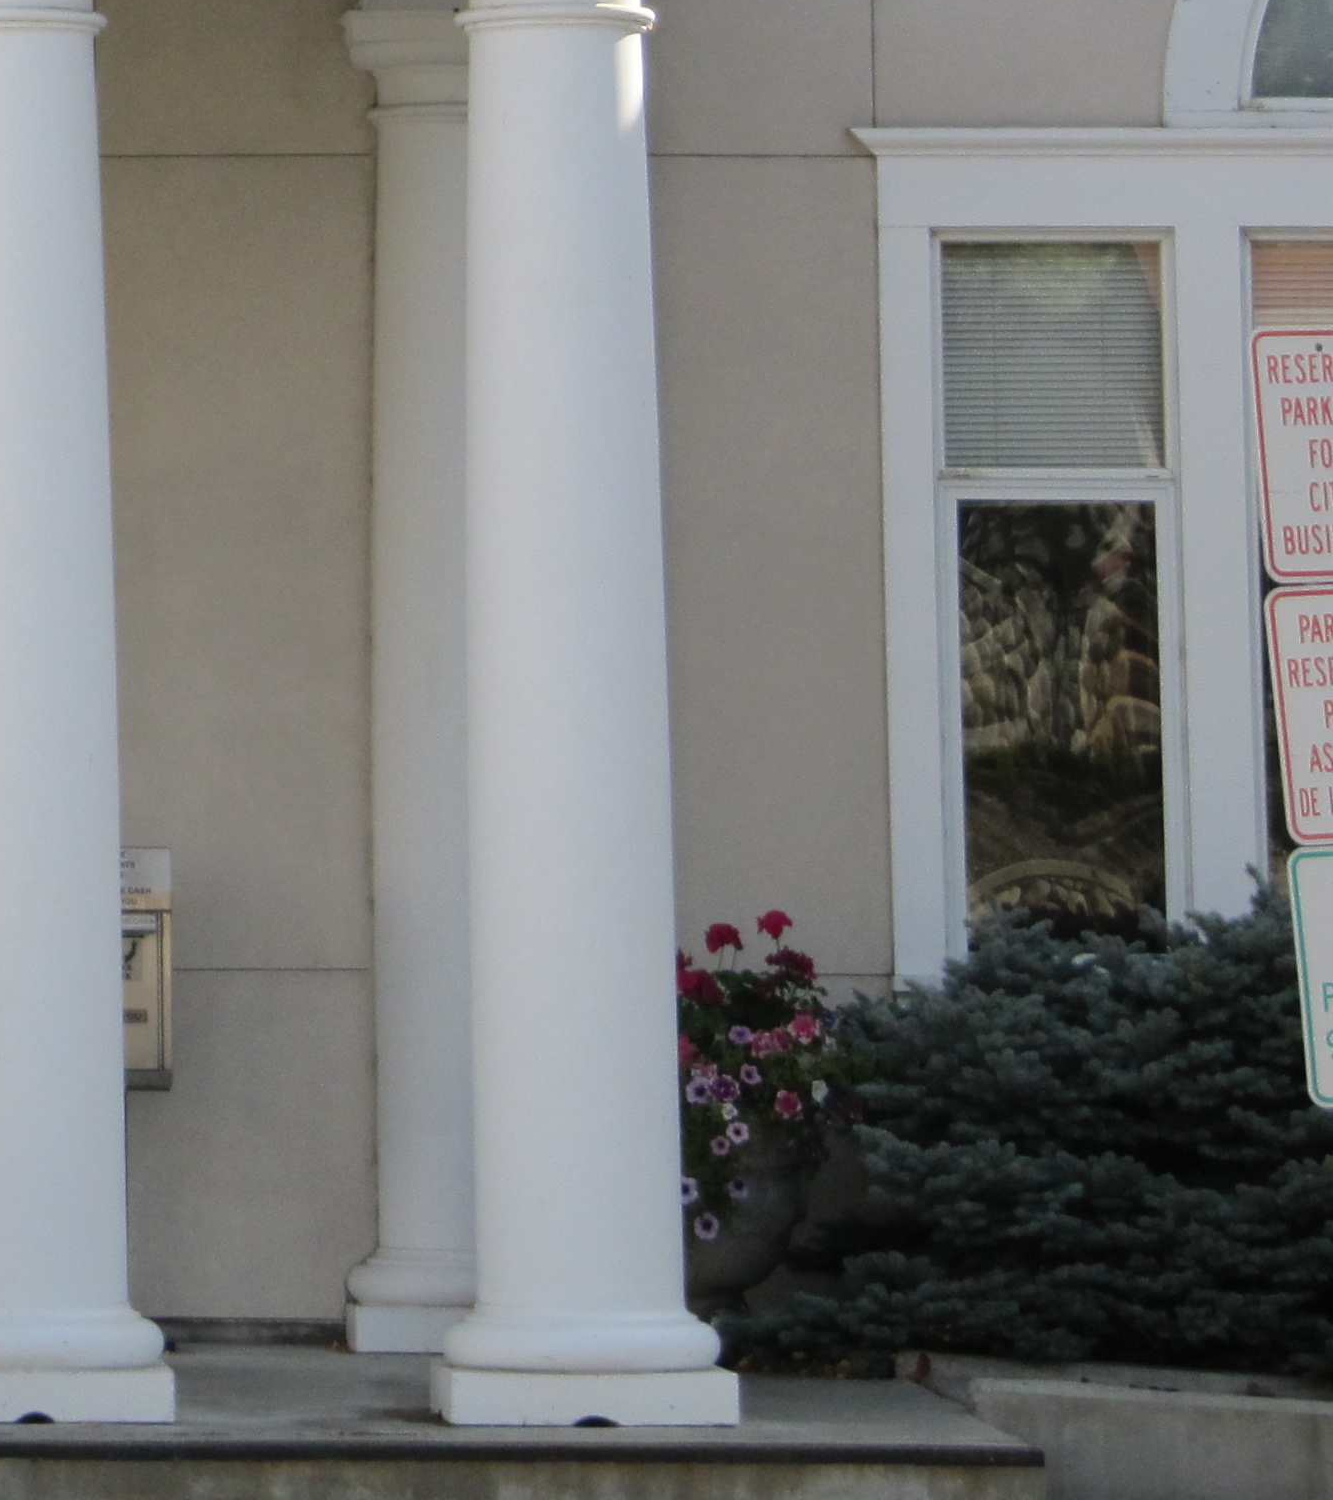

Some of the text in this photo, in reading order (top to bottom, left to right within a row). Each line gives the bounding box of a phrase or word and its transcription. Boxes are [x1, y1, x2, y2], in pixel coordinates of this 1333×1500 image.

[1267, 353, 1333, 384] RESER
[1281, 395, 1333, 426] PARK
[1308, 438, 1333, 469] FO
[1282, 523, 1333, 556] BUSI
[1298, 613, 1333, 644] PAR
[1310, 743, 1333, 774] AS
[1299, 786, 1321, 817] DE
